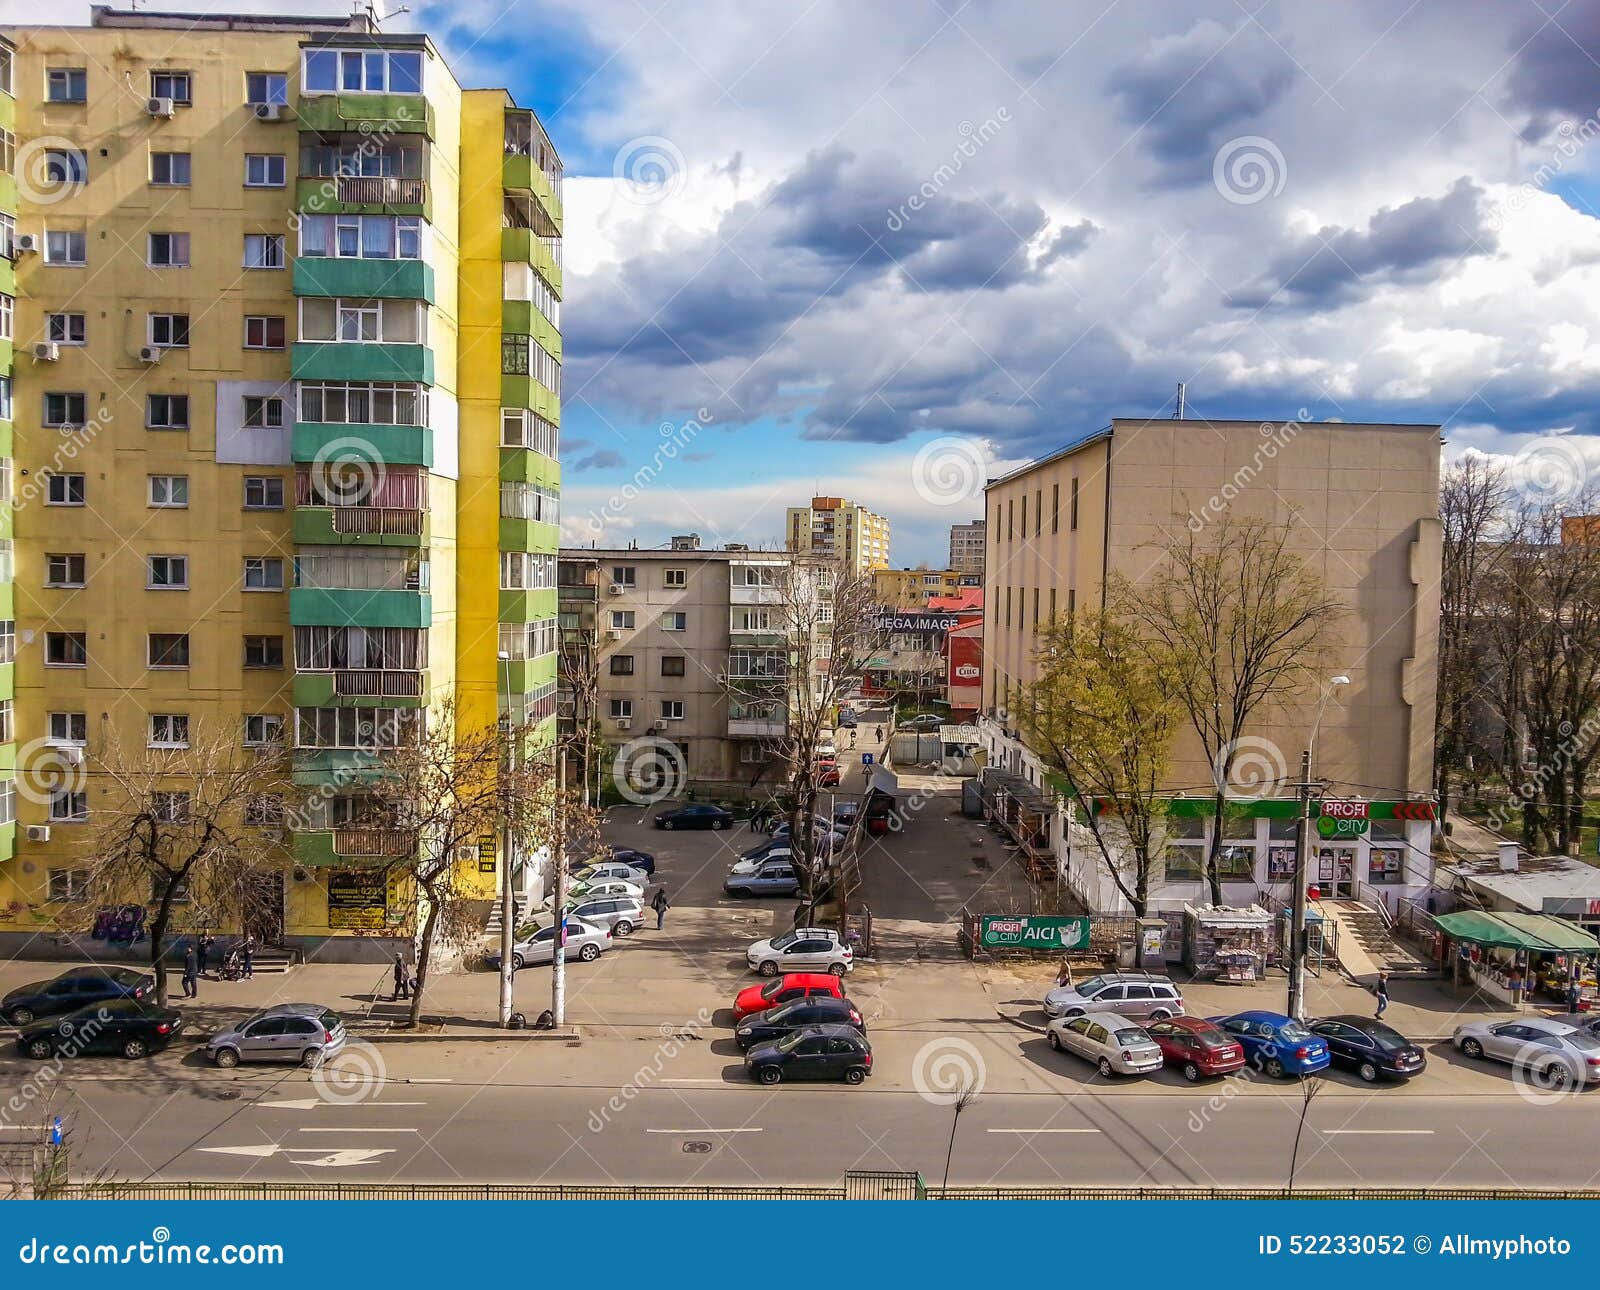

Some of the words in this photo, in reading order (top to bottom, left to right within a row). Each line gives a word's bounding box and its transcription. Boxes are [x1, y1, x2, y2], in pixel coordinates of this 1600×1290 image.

[874, 618, 912, 629] MEGA
[916, 618, 959, 629] IMAGE
[1326, 803, 1365, 816] PROFI
[1337, 819, 1365, 832] CITY
[992, 922, 1019, 932] PROFI
[999, 932, 1019, 941] CITY
[1023, 927, 1055, 940] AICI
